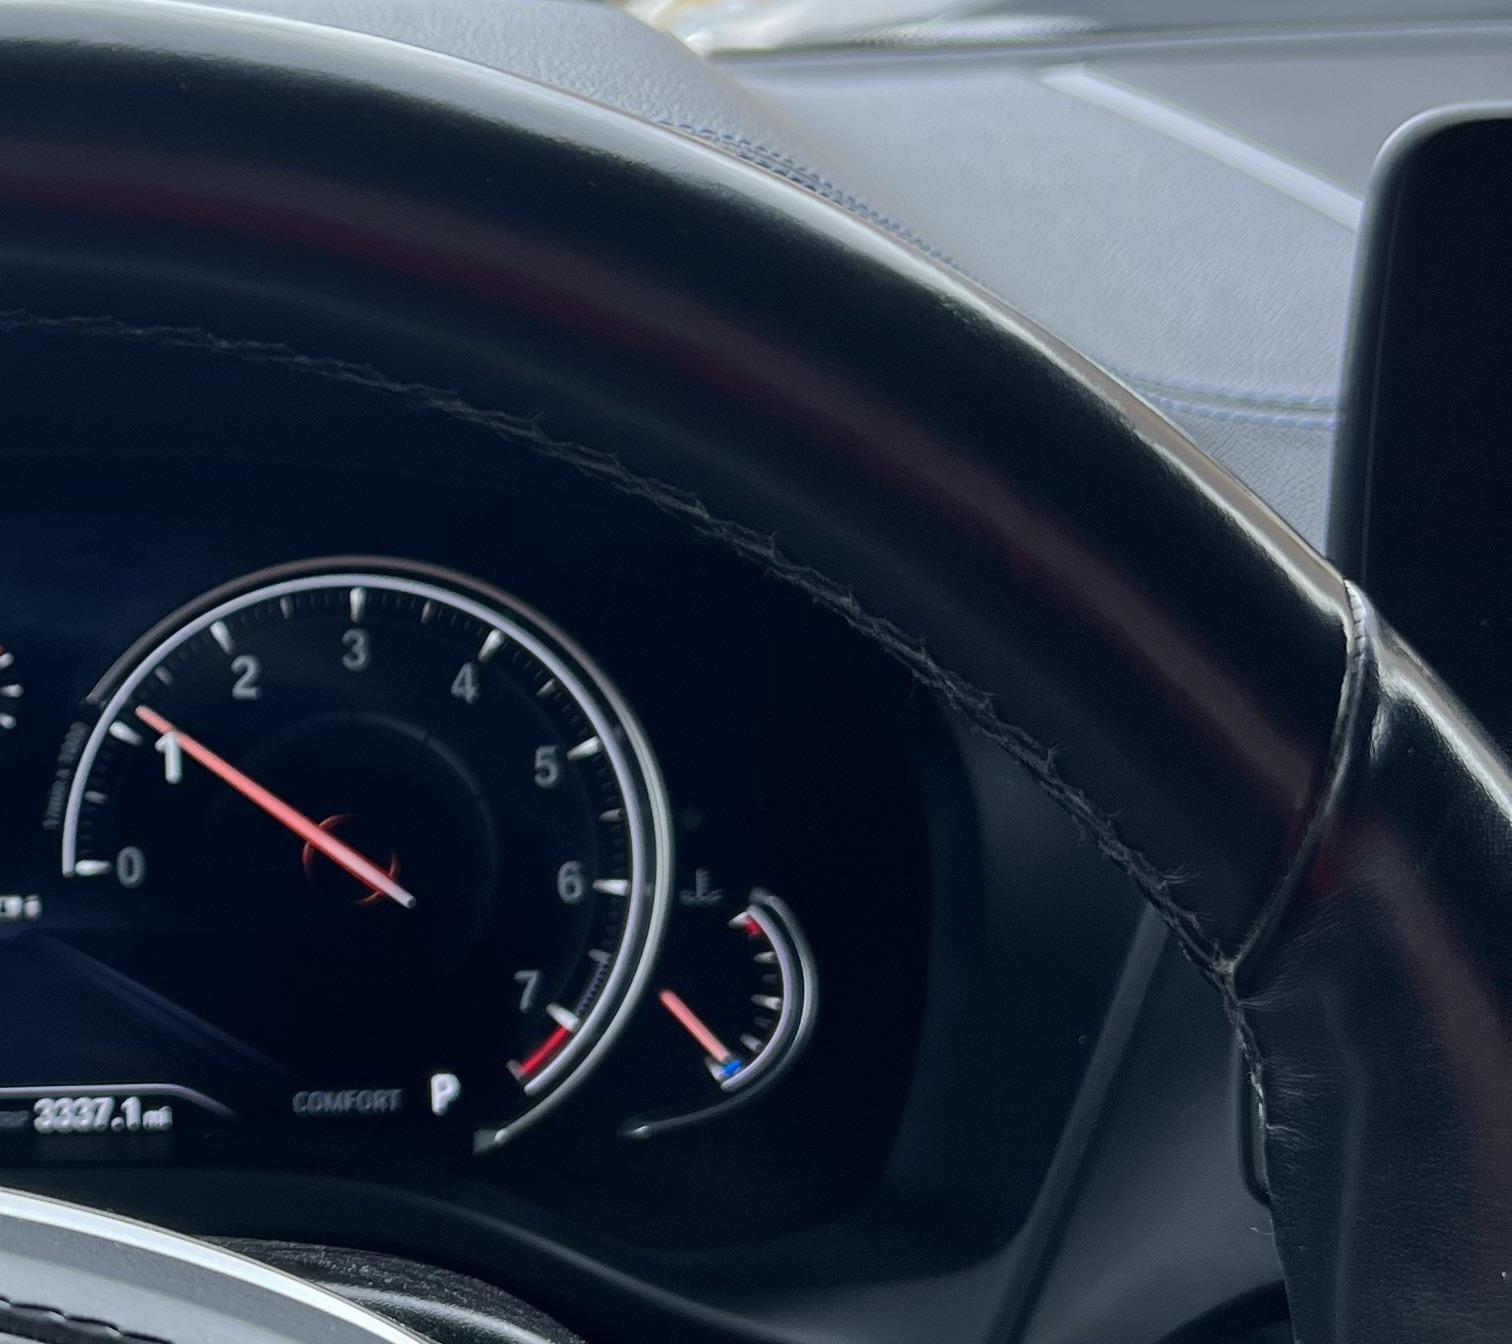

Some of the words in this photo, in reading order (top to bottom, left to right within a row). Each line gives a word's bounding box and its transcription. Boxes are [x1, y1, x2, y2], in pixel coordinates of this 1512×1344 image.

[342, 630, 368, 670] 3
[231, 656, 260, 699] 2
[451, 661, 480, 703] 4
[155, 734, 184, 783] 1
[534, 745, 561, 787] 5
[116, 845, 145, 887] 0
[557, 859, 584, 903] 6
[514, 969, 542, 1013] 7
[291, 1087, 405, 1115] COMFORT
[430, 1072, 462, 1117] P
